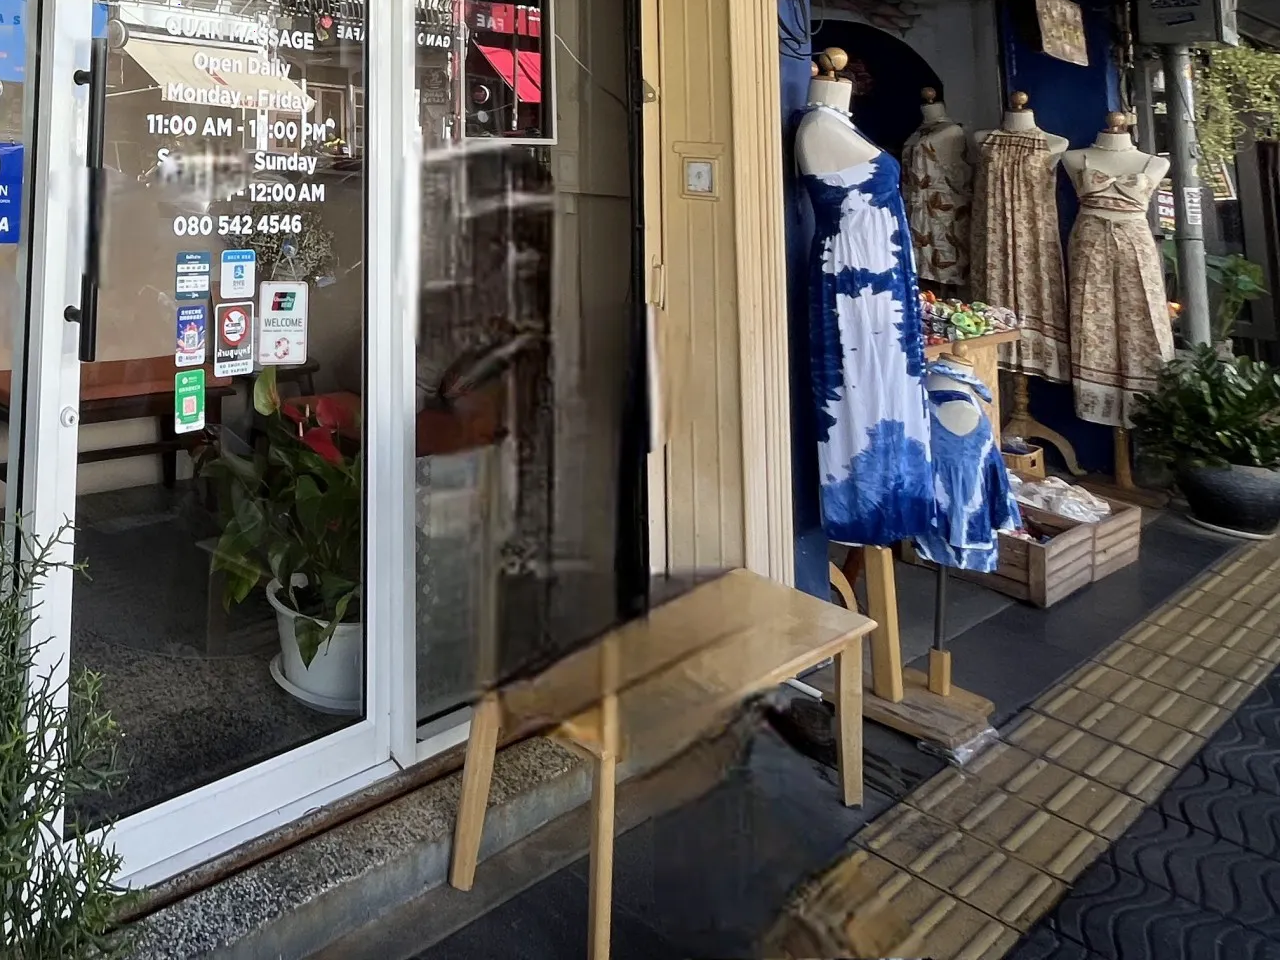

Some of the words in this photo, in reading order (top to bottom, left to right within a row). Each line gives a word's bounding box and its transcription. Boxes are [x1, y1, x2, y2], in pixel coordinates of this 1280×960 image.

[165, 16, 223, 41] QUAN
[230, 22, 314, 50] MASSAGE
[193, 51, 242, 74] Open
[248, 56, 291, 81] Daily
[167, 82, 241, 108] Monday
[257, 89, 310, 111] Friday
[146, 113, 197, 136] 11:00
[202, 117, 232, 137] AM
[303, 122, 326, 141] PM
[254, 151, 318, 174] Sunday
[249, 183, 297, 202] 12:00
[298, 183, 325, 202] AM
[173, 216, 213, 236] 080
[217, 215, 253, 235] 542
[256, 214, 302, 234] 4546
[264, 317, 303, 328] WELCOME
